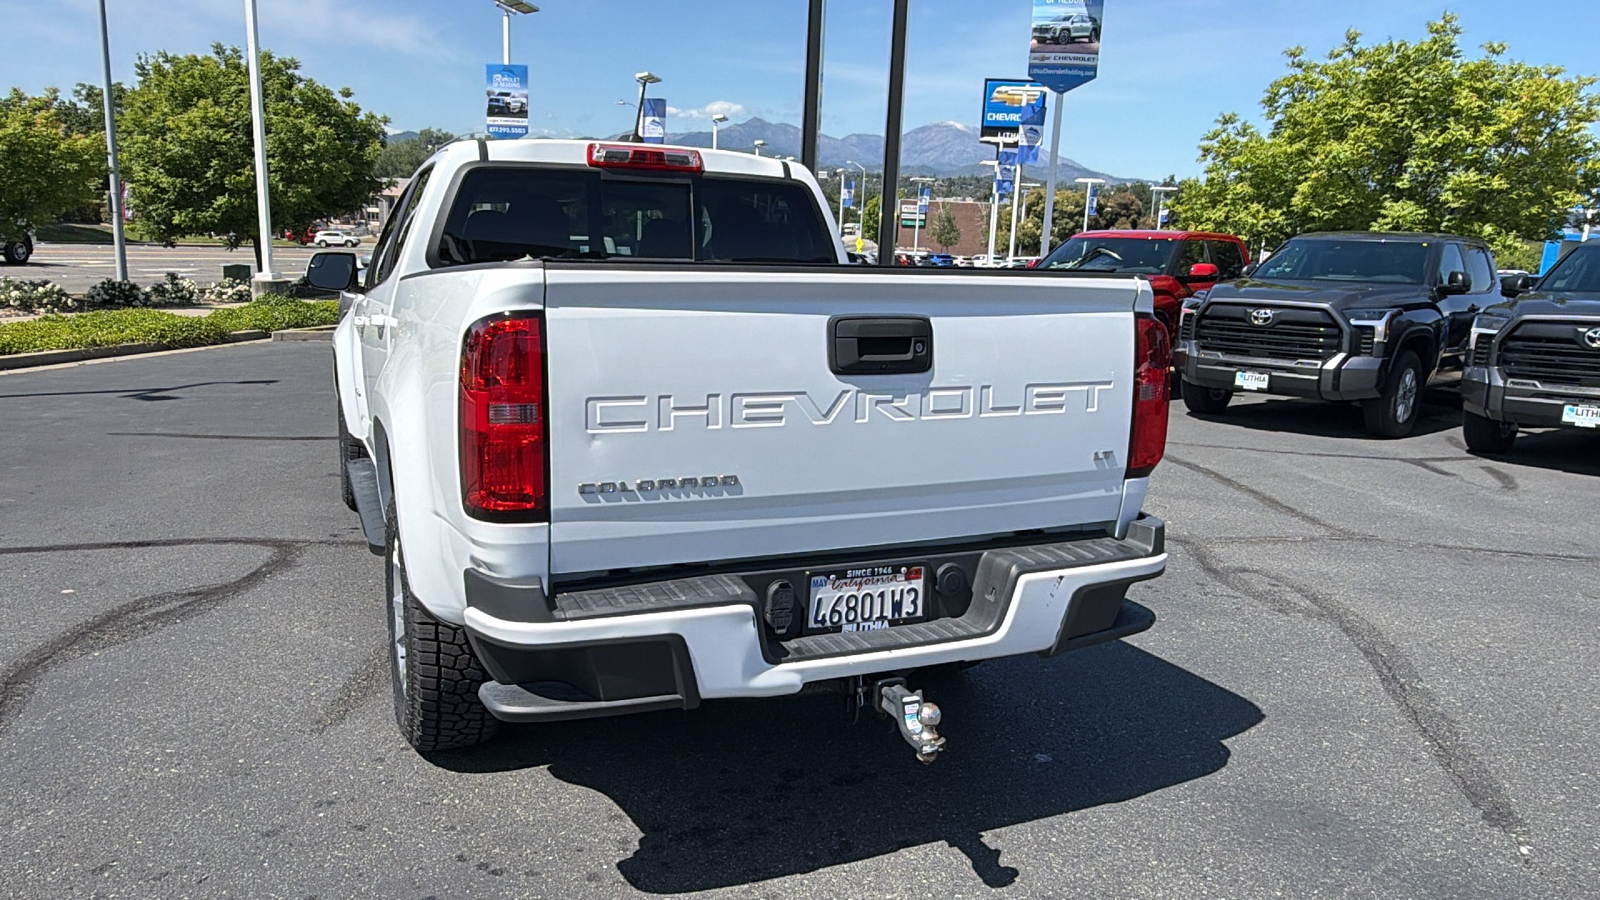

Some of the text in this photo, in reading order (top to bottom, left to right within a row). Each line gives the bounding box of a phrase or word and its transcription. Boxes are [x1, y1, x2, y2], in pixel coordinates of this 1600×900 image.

[1243, 374, 1267, 382] LITHIA
[585, 380, 1114, 434] CHEVROLET
[1094, 451, 1113, 461] LT
[578, 474, 739, 494] COLORADO
[846, 568, 872, 578] SINCE
[812, 578, 828, 588] MAY
[830, 574, 905, 592] California
[813, 587, 919, 626] 46801W3
